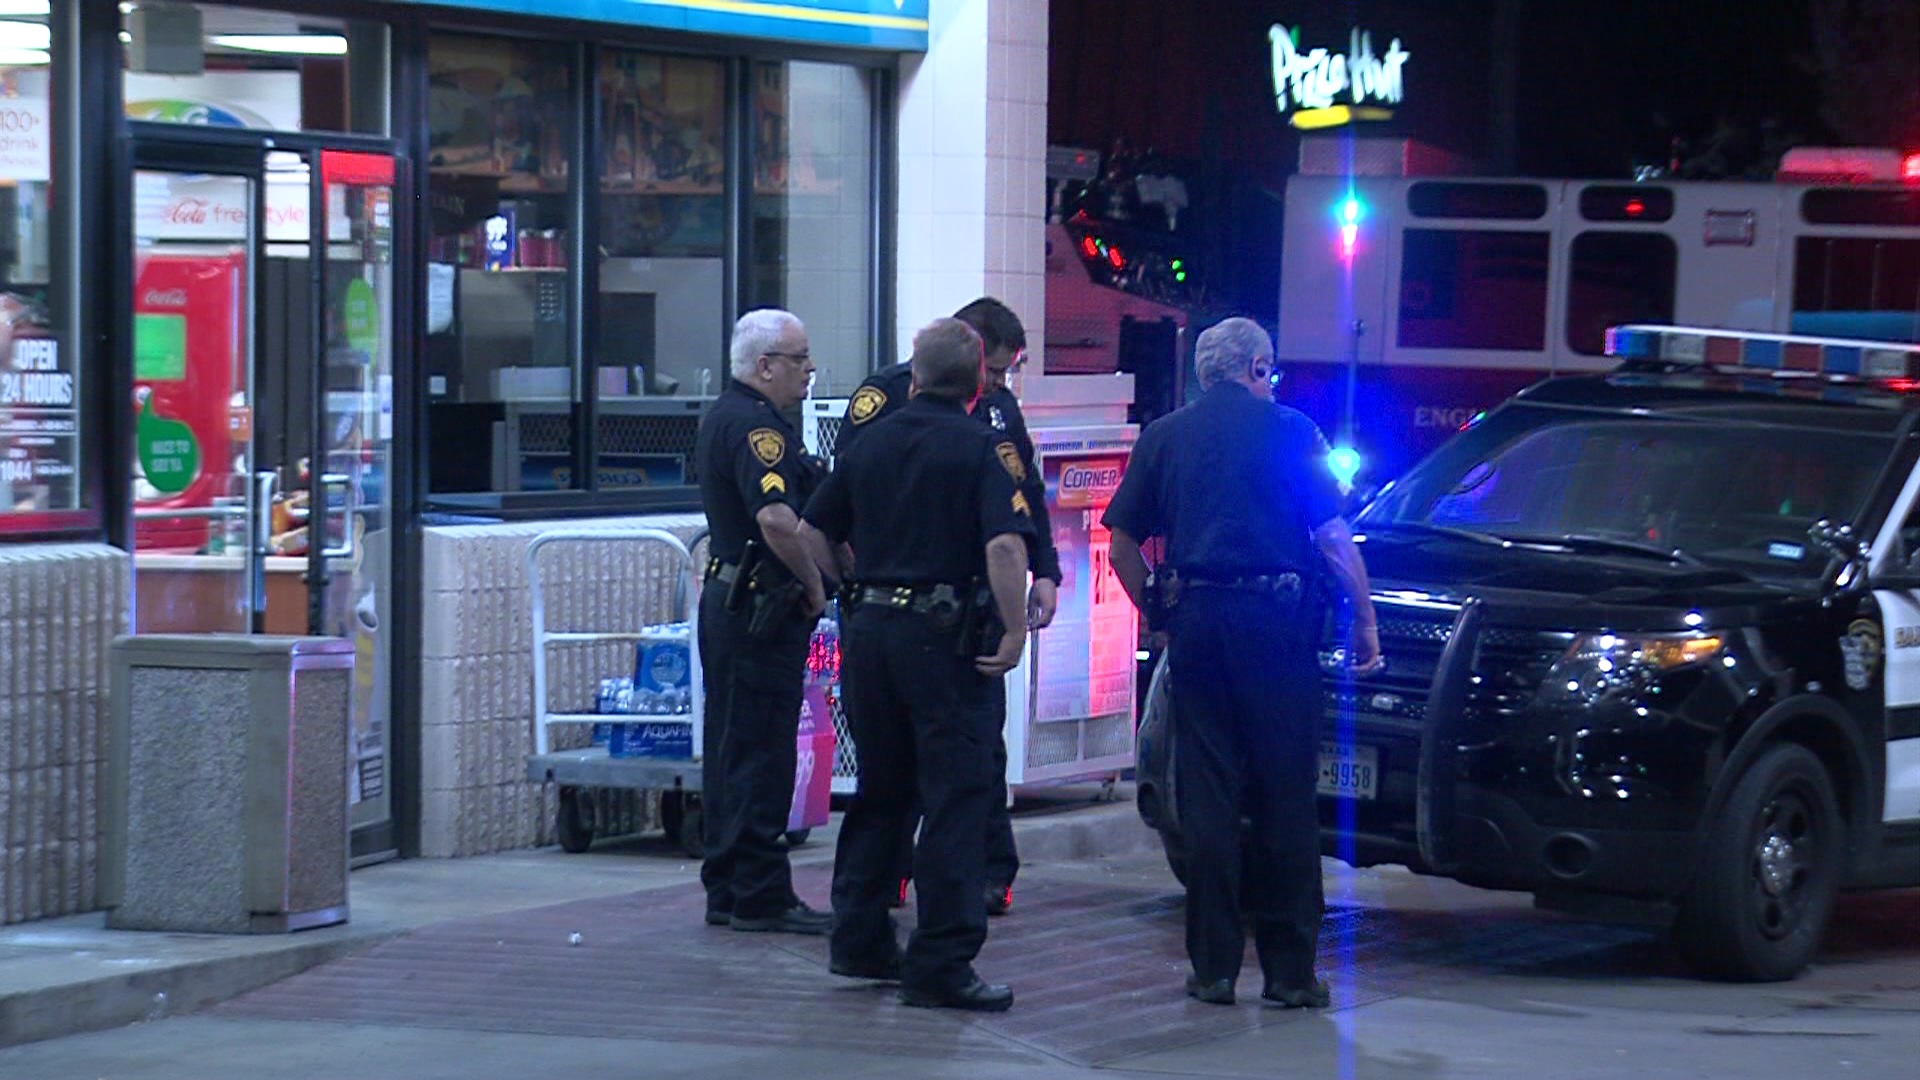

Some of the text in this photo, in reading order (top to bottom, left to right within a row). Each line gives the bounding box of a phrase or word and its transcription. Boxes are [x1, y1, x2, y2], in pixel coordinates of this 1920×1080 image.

[1268, 22, 1411, 112] Pizza Hut
[18, 339, 58, 370] OPEN
[2, 372, 73, 404] 24 HOURS
[1062, 467, 1117, 488] CORNER
[642, 724, 693, 740] AQUAFIN
